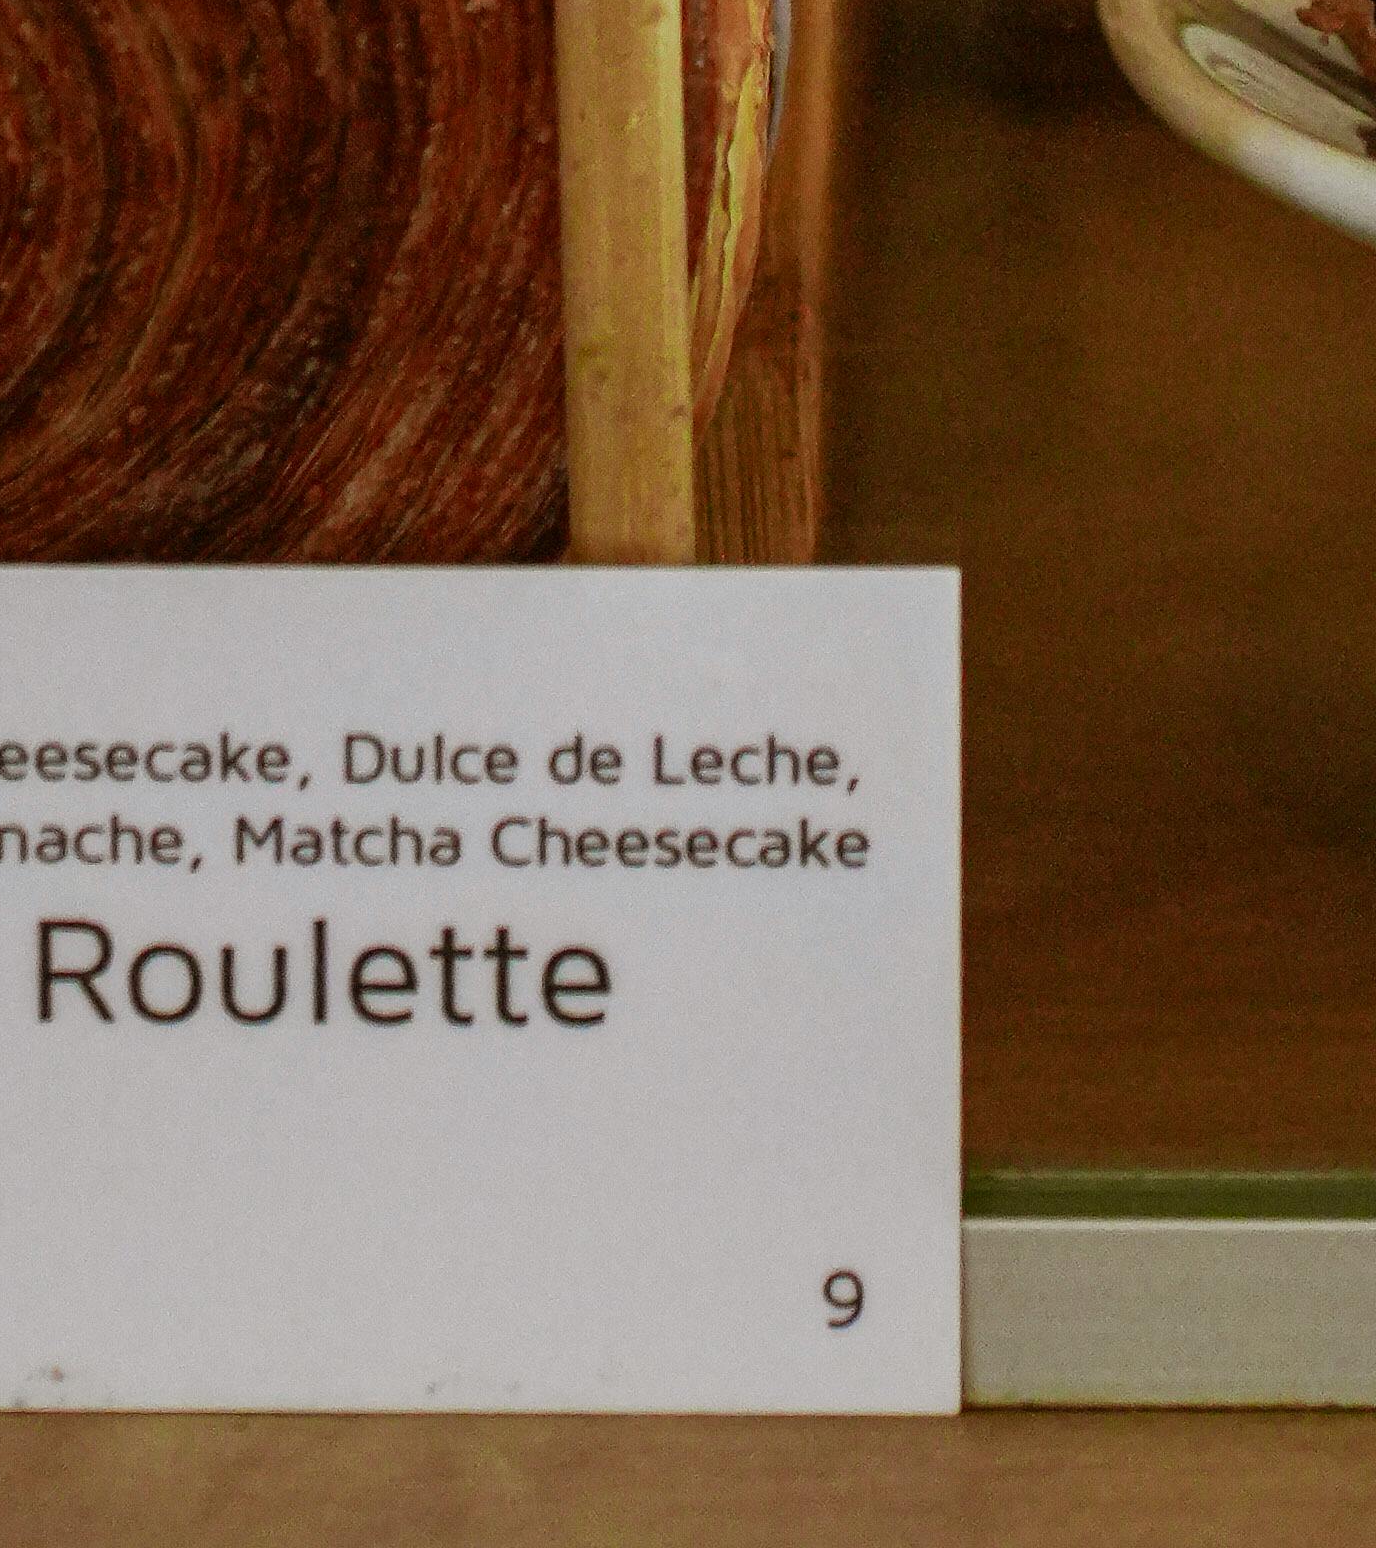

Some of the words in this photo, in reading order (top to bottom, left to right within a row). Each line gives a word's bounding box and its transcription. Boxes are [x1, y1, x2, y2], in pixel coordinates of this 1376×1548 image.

[342, 731, 520, 787] Dulce
[546, 733, 624, 788] de
[652, 733, 861, 794] Leche,
[233, 815, 463, 869] Matcha
[490, 815, 872, 871] Cheesecake
[35, 916, 614, 1031] Roulette
[820, 1267, 867, 1331] 9
